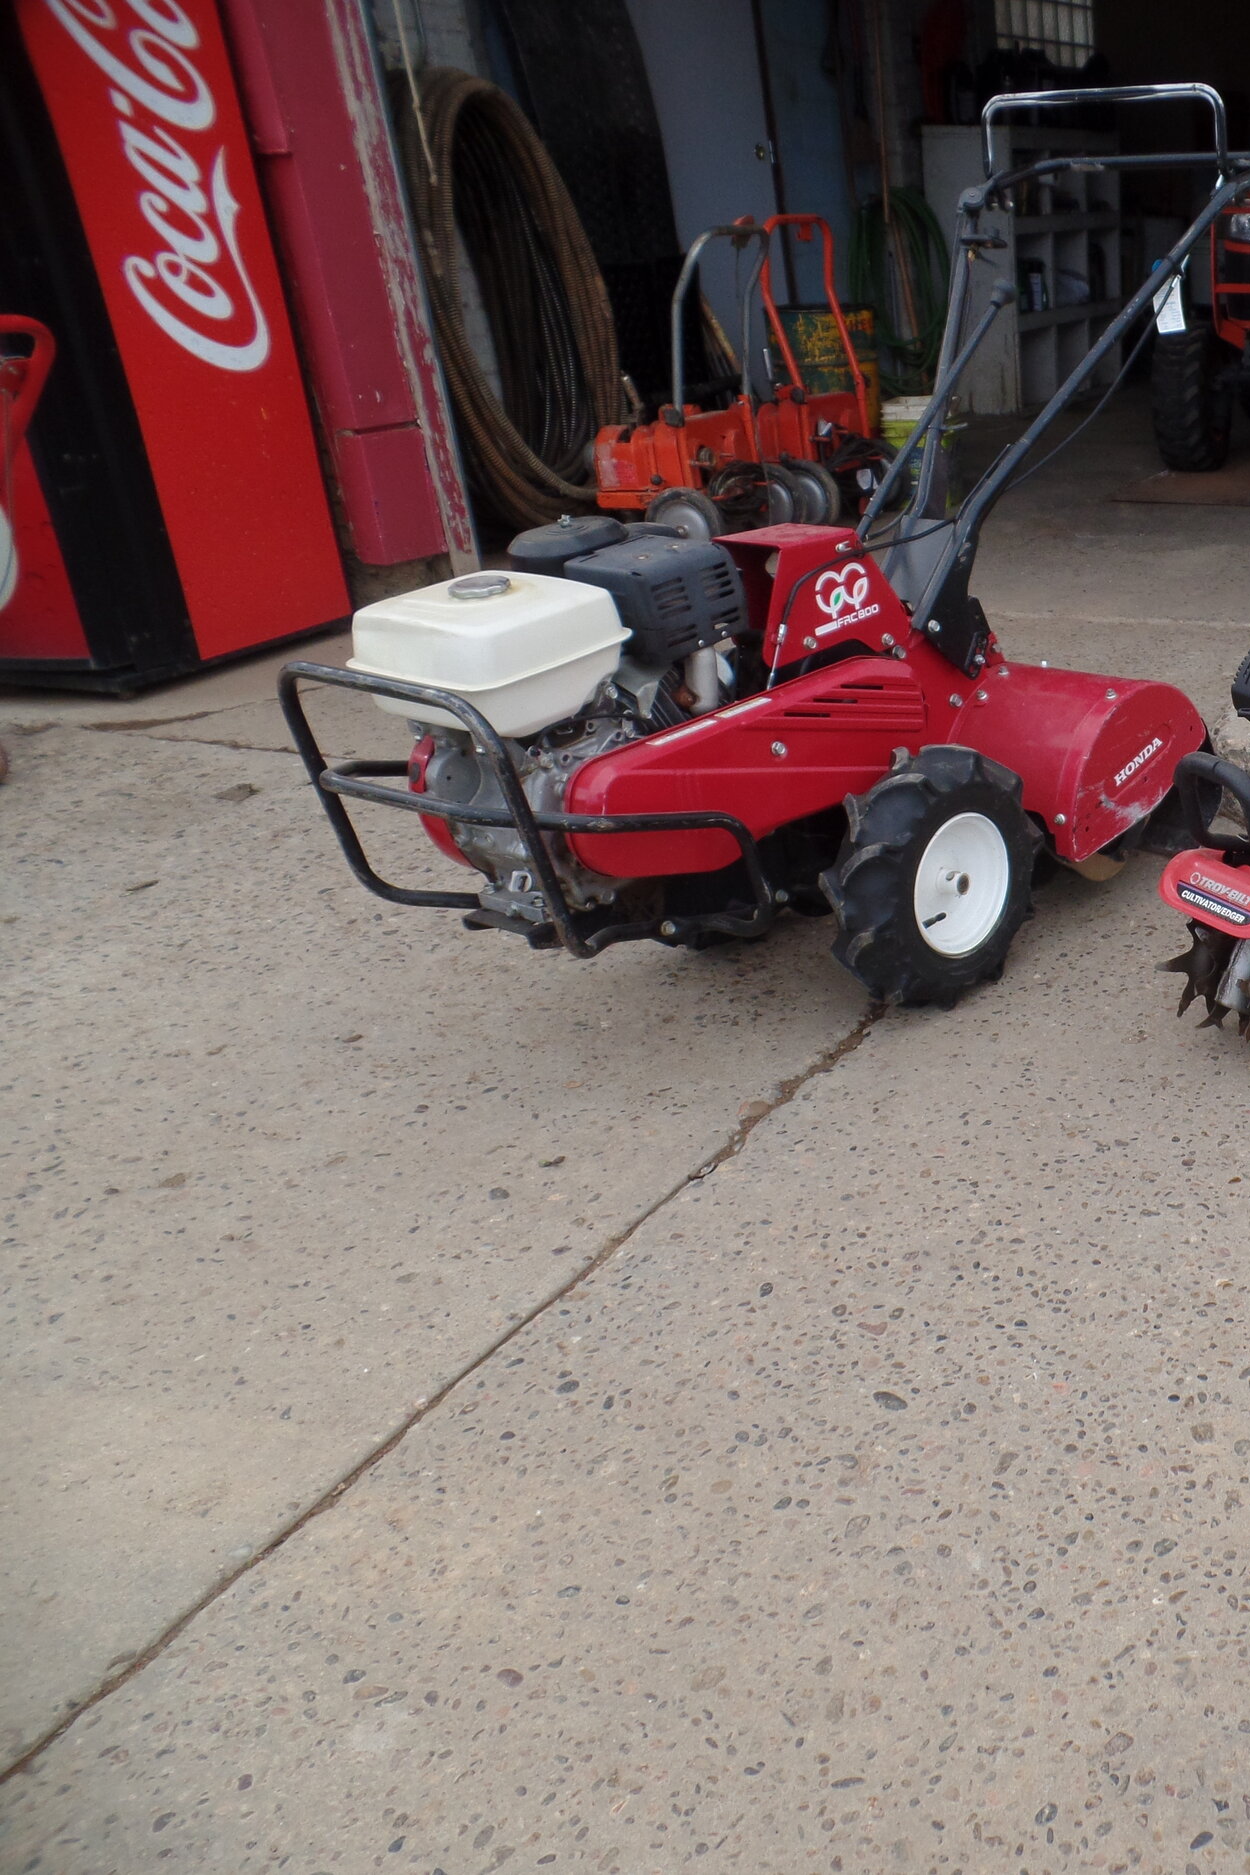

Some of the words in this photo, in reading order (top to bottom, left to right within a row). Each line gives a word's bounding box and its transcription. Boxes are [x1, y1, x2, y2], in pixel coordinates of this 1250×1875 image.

[838, 603, 879, 628] FRC800
[1113, 737, 1163, 786] HONDA
[1181, 890, 1246, 923] CULTIVATOR/EDGER
